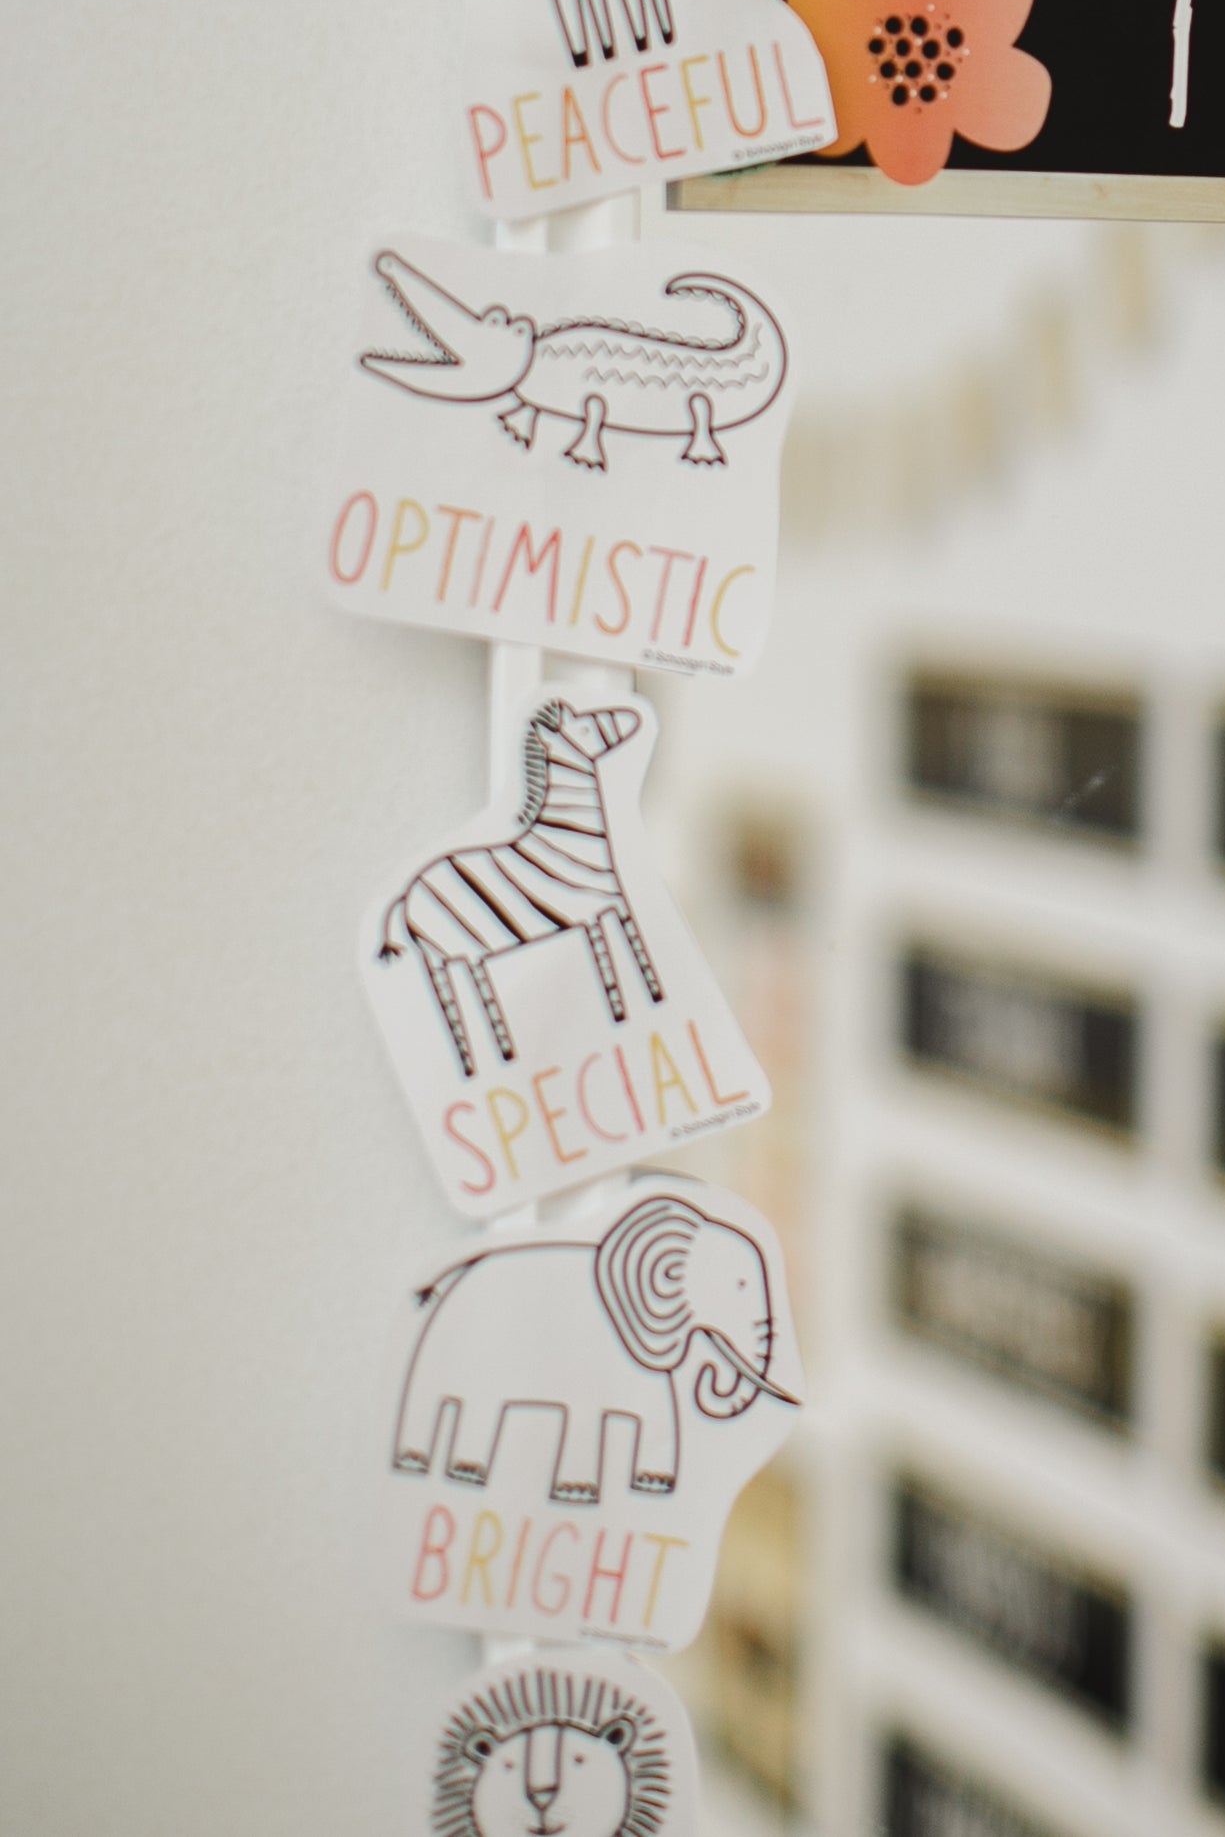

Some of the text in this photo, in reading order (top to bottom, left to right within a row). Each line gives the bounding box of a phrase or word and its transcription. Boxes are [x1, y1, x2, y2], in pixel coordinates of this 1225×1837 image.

[468, 40, 825, 200] PEACEFUL
[330, 490, 755, 657] OPTIMISTIC
[444, 1019, 750, 1194] SPECIAL
[411, 1504, 690, 1630] BRIGHT
